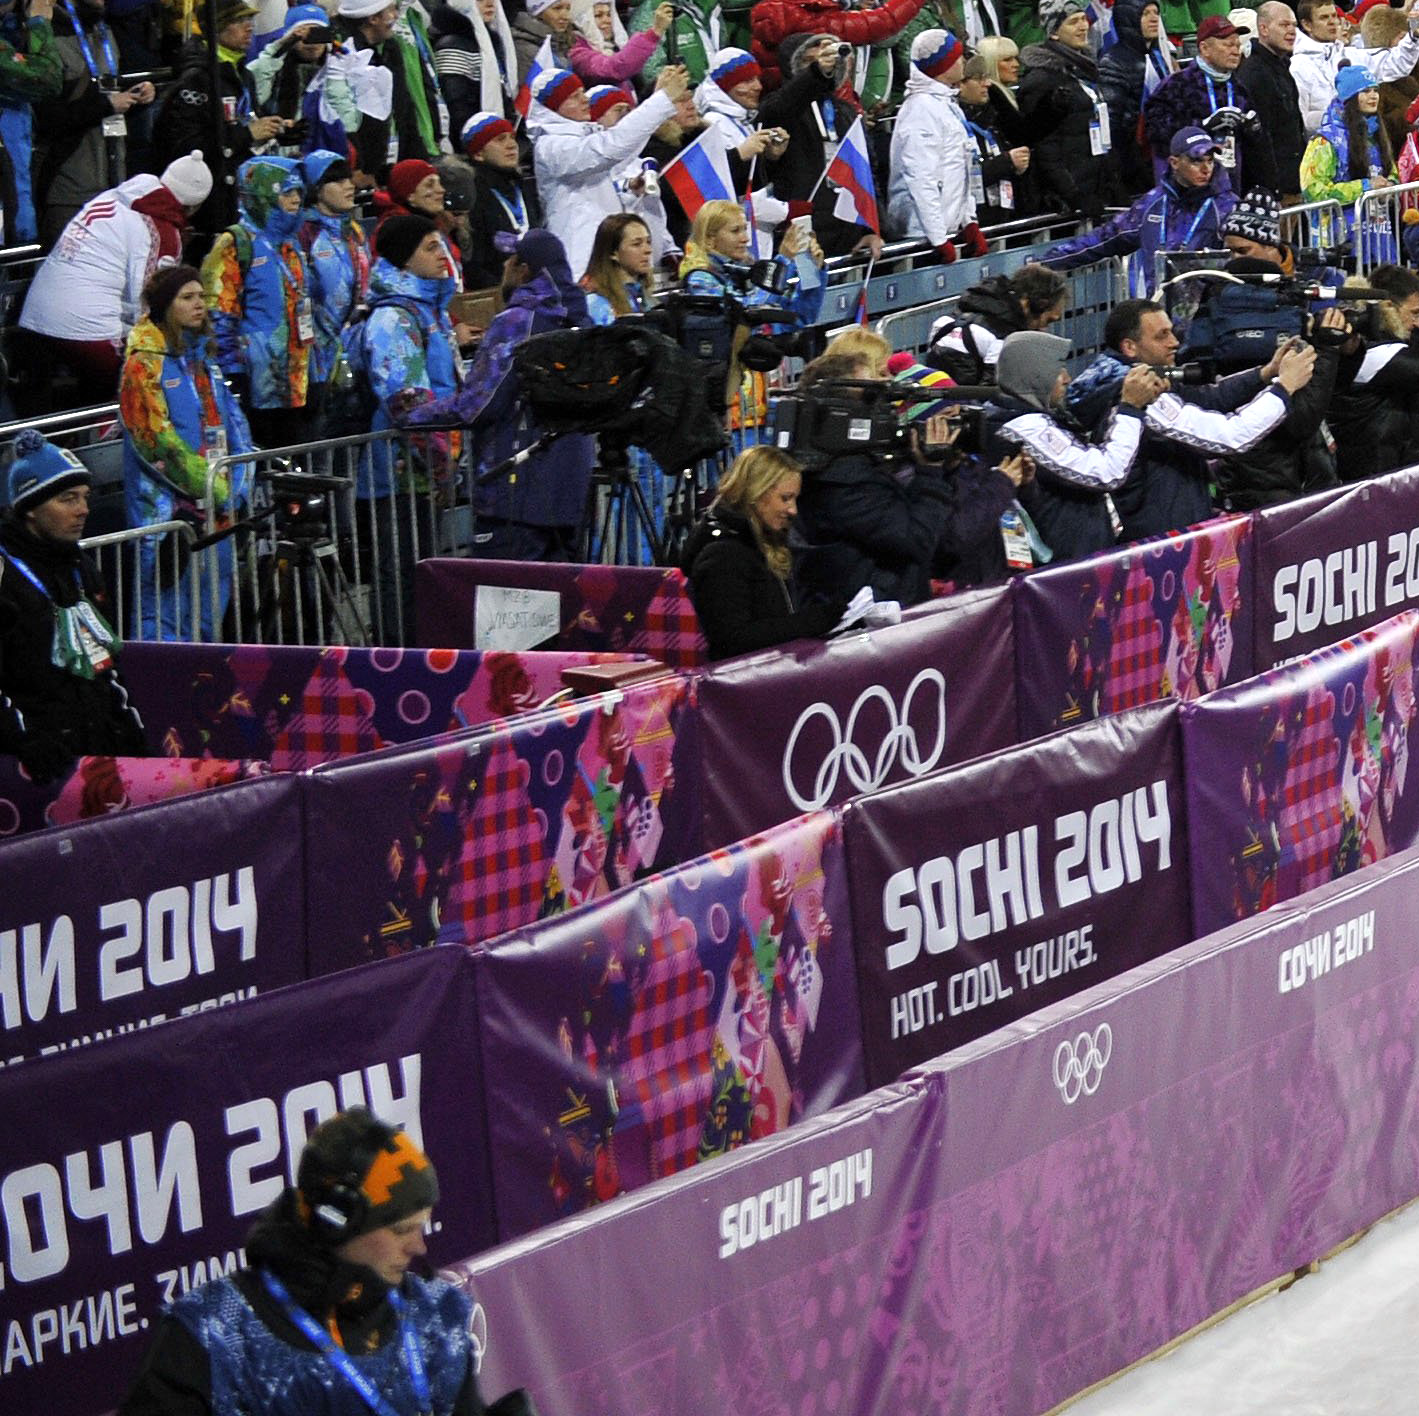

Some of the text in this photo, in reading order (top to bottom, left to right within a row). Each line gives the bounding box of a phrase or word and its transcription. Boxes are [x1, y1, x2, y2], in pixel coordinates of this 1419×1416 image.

[1273, 541, 1376, 642] SOCHI
[884, 780, 1172, 970] SOCHI 2014
[99, 865, 258, 1001] 2014
[890, 923, 1098, 1041] HOT. COOL. YOURS.
[1278, 910, 1376, 993] СОЧИ 2014
[0, 1120, 203, 1291] ОЧИ
[718, 1147, 874, 1259] SOCHI 2014
[0, 1282, 150, 1376] АРКИЕ.
